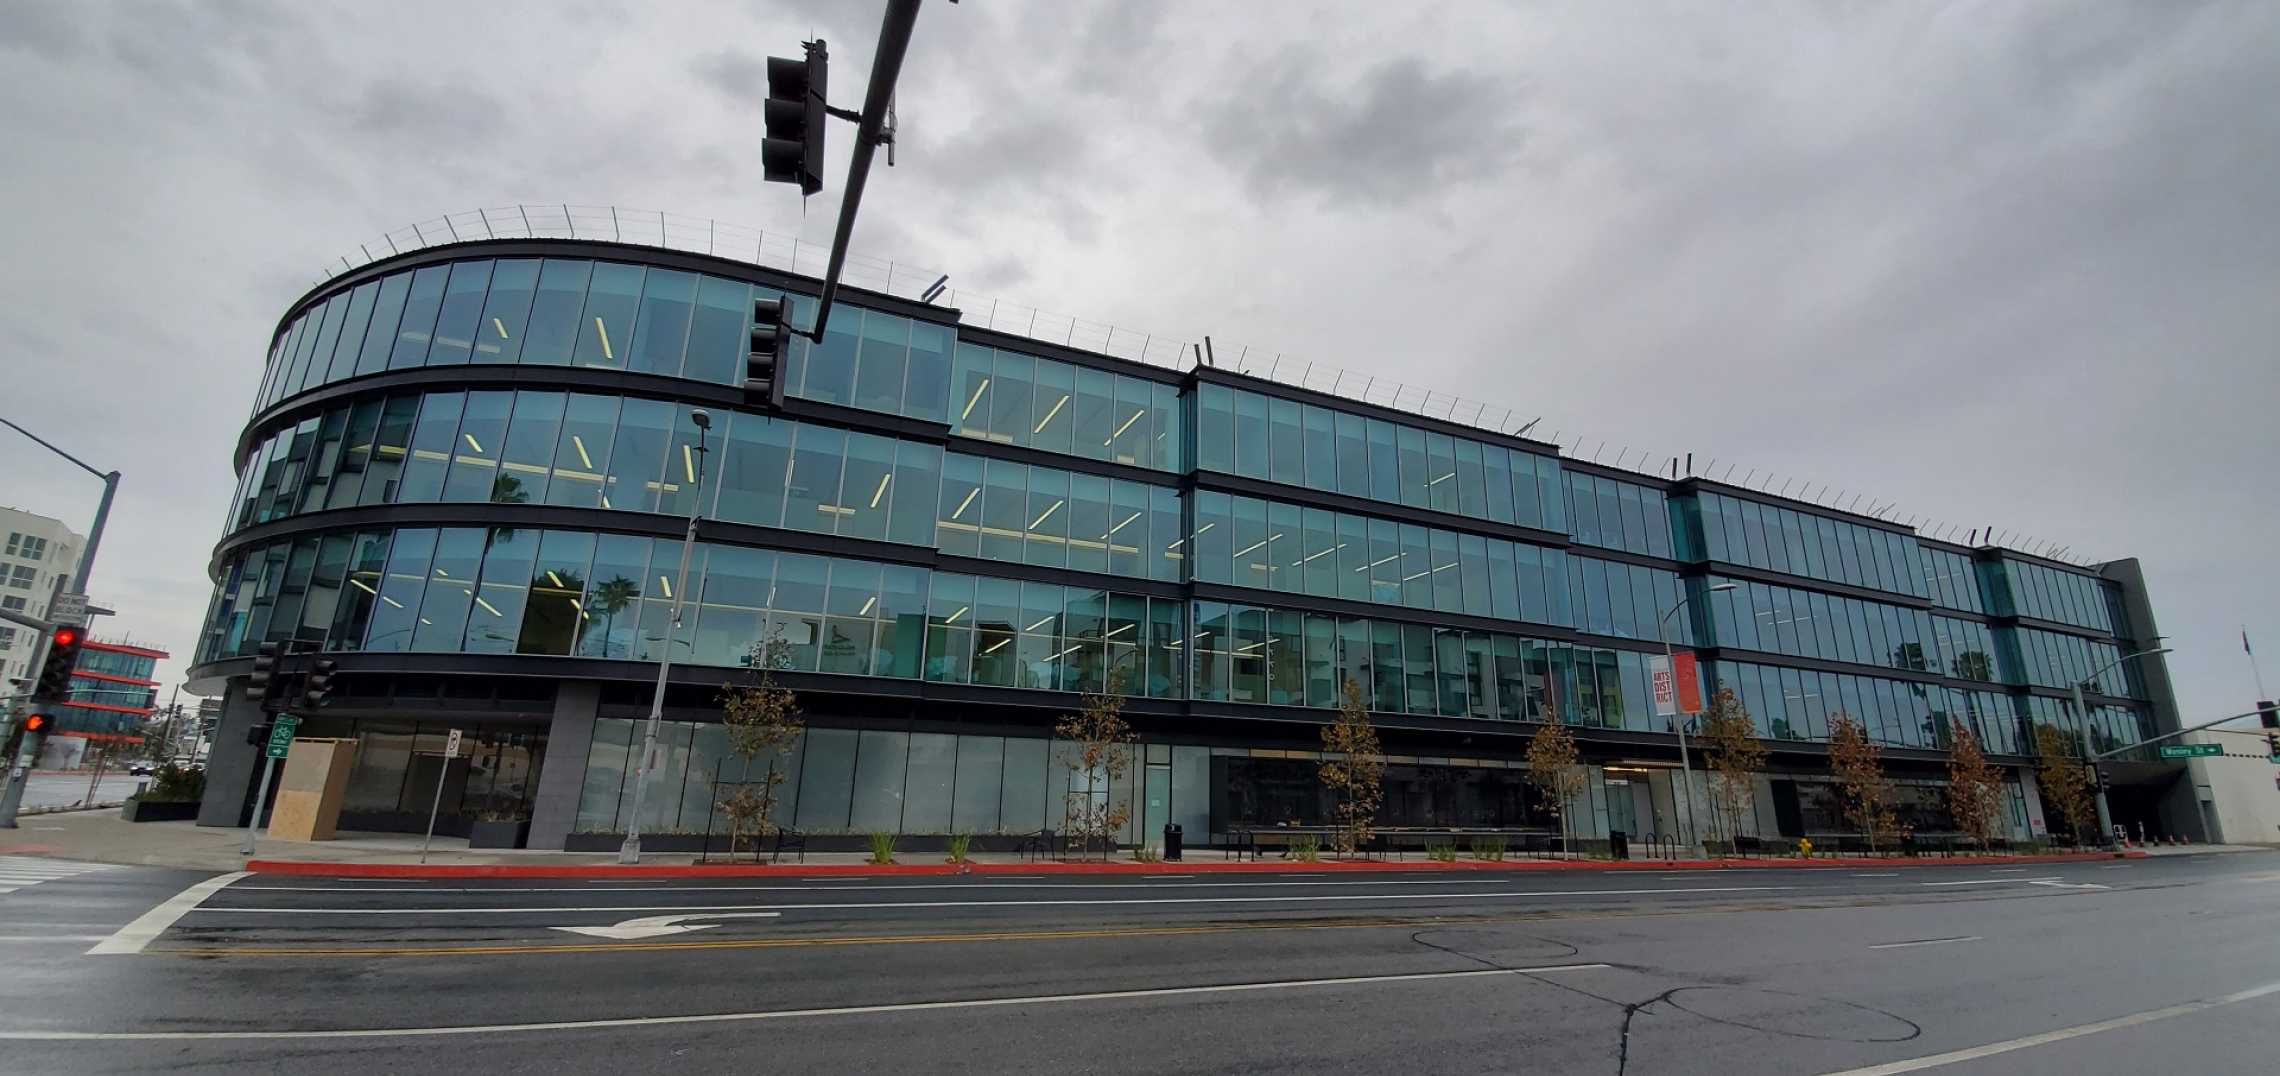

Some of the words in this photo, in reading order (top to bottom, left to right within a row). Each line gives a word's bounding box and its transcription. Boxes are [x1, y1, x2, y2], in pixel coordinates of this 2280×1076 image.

[1654, 671, 1671, 681] ARTS
[1654, 681, 1671, 692] DIST
[1656, 692, 1672, 703] RICT
